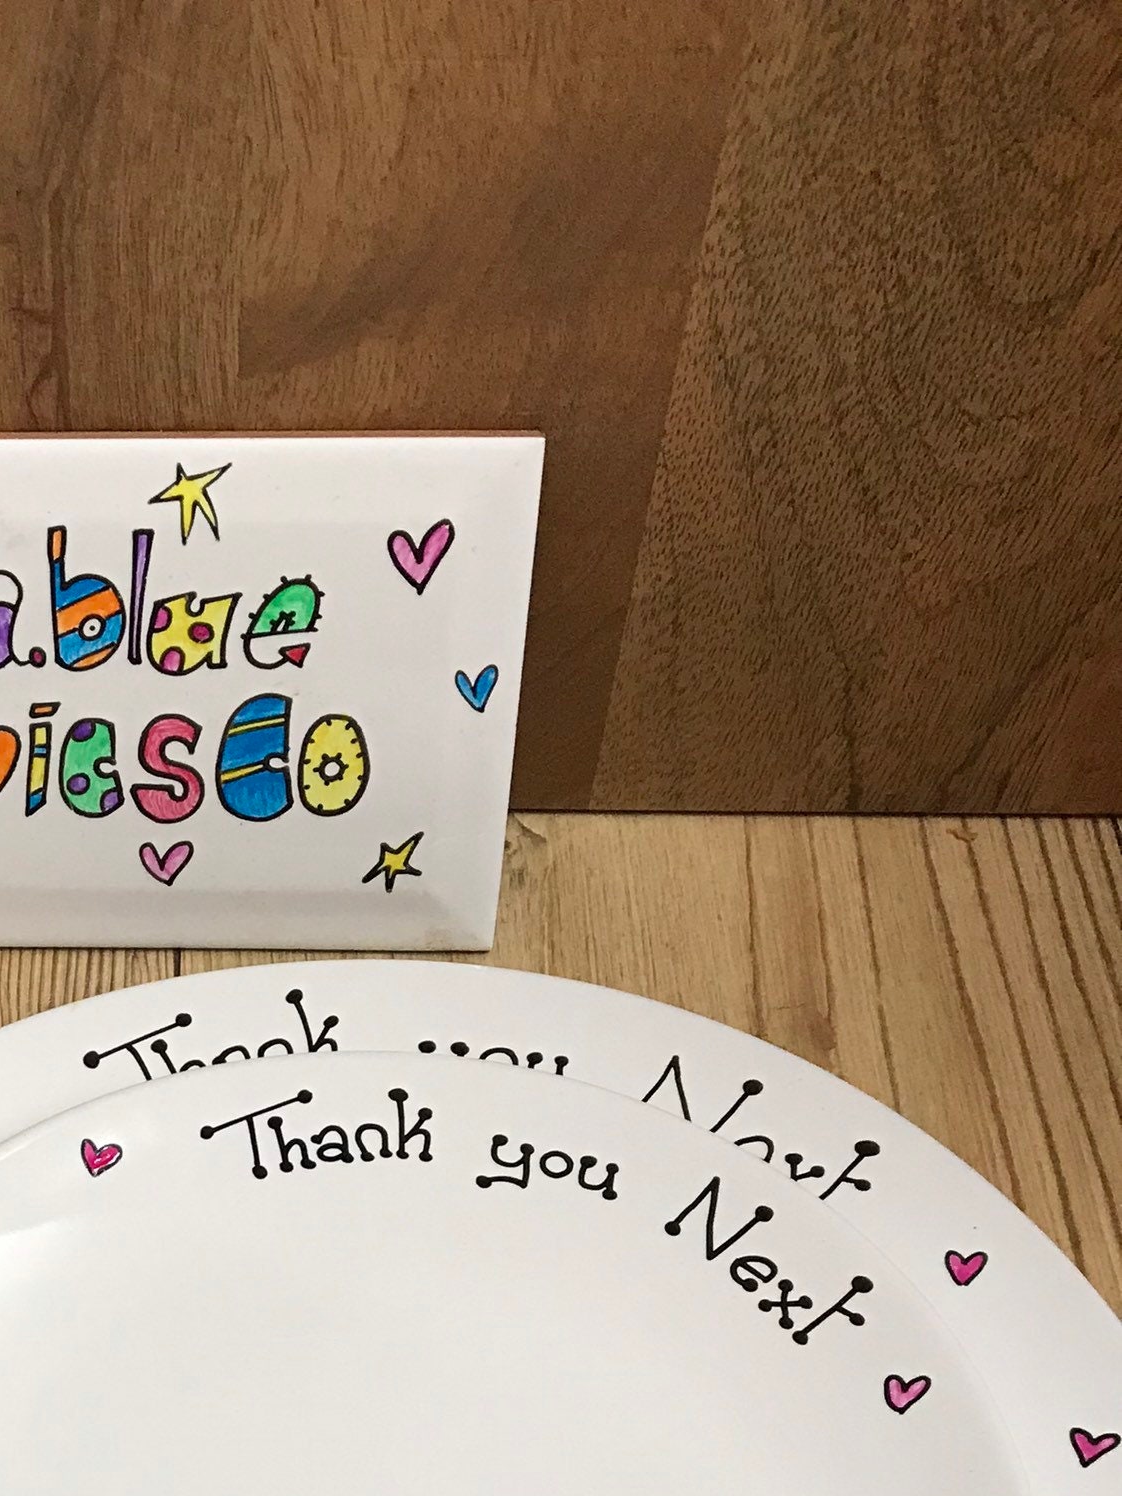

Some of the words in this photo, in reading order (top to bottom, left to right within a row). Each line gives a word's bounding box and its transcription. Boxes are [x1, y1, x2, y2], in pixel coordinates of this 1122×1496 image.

[200, 1088, 434, 1180] Thank
[476, 1133, 620, 1201] you
[664, 1175, 875, 1346] Next
